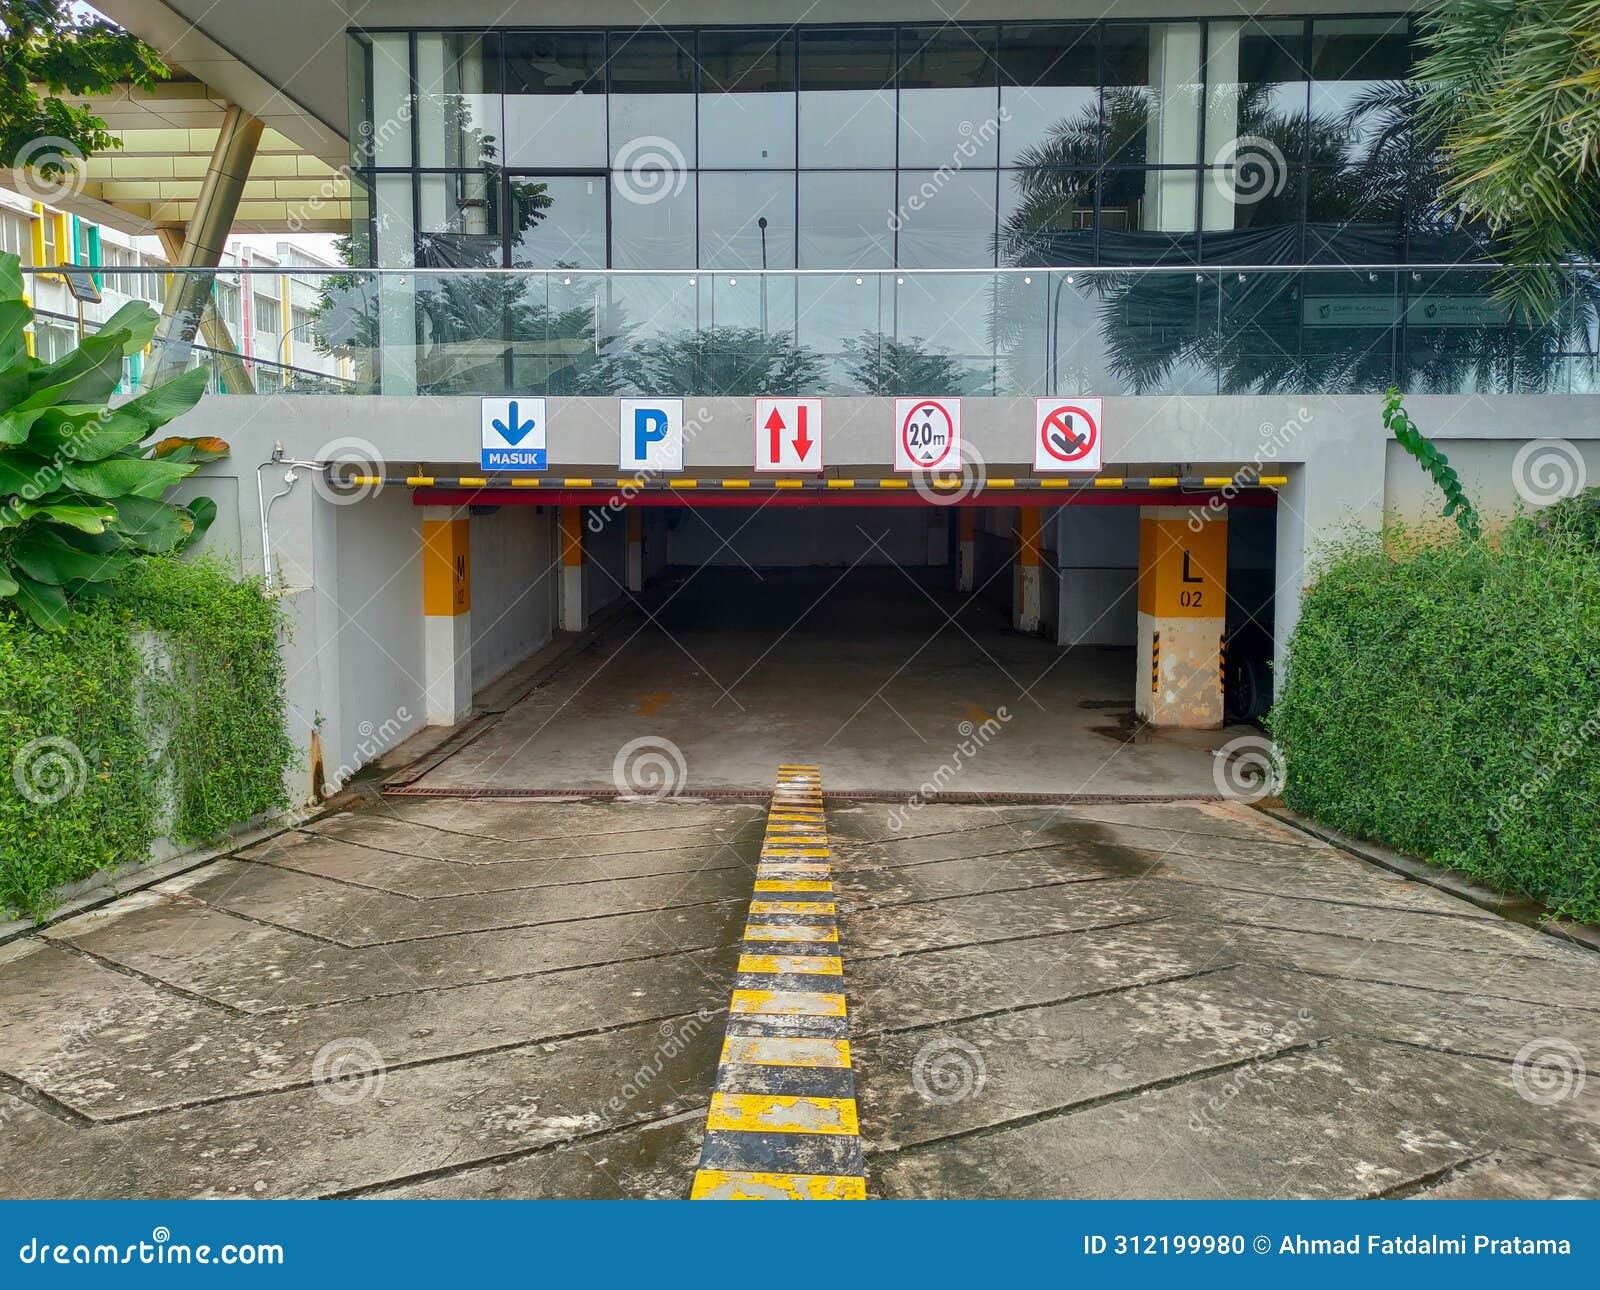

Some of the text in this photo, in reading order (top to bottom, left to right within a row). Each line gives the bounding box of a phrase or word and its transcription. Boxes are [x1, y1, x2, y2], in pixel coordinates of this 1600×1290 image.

[635, 408, 668, 460] P
[489, 453, 538, 465] MASUK
[1183, 549, 1204, 583] L
[1180, 592, 1203, 608] 02
